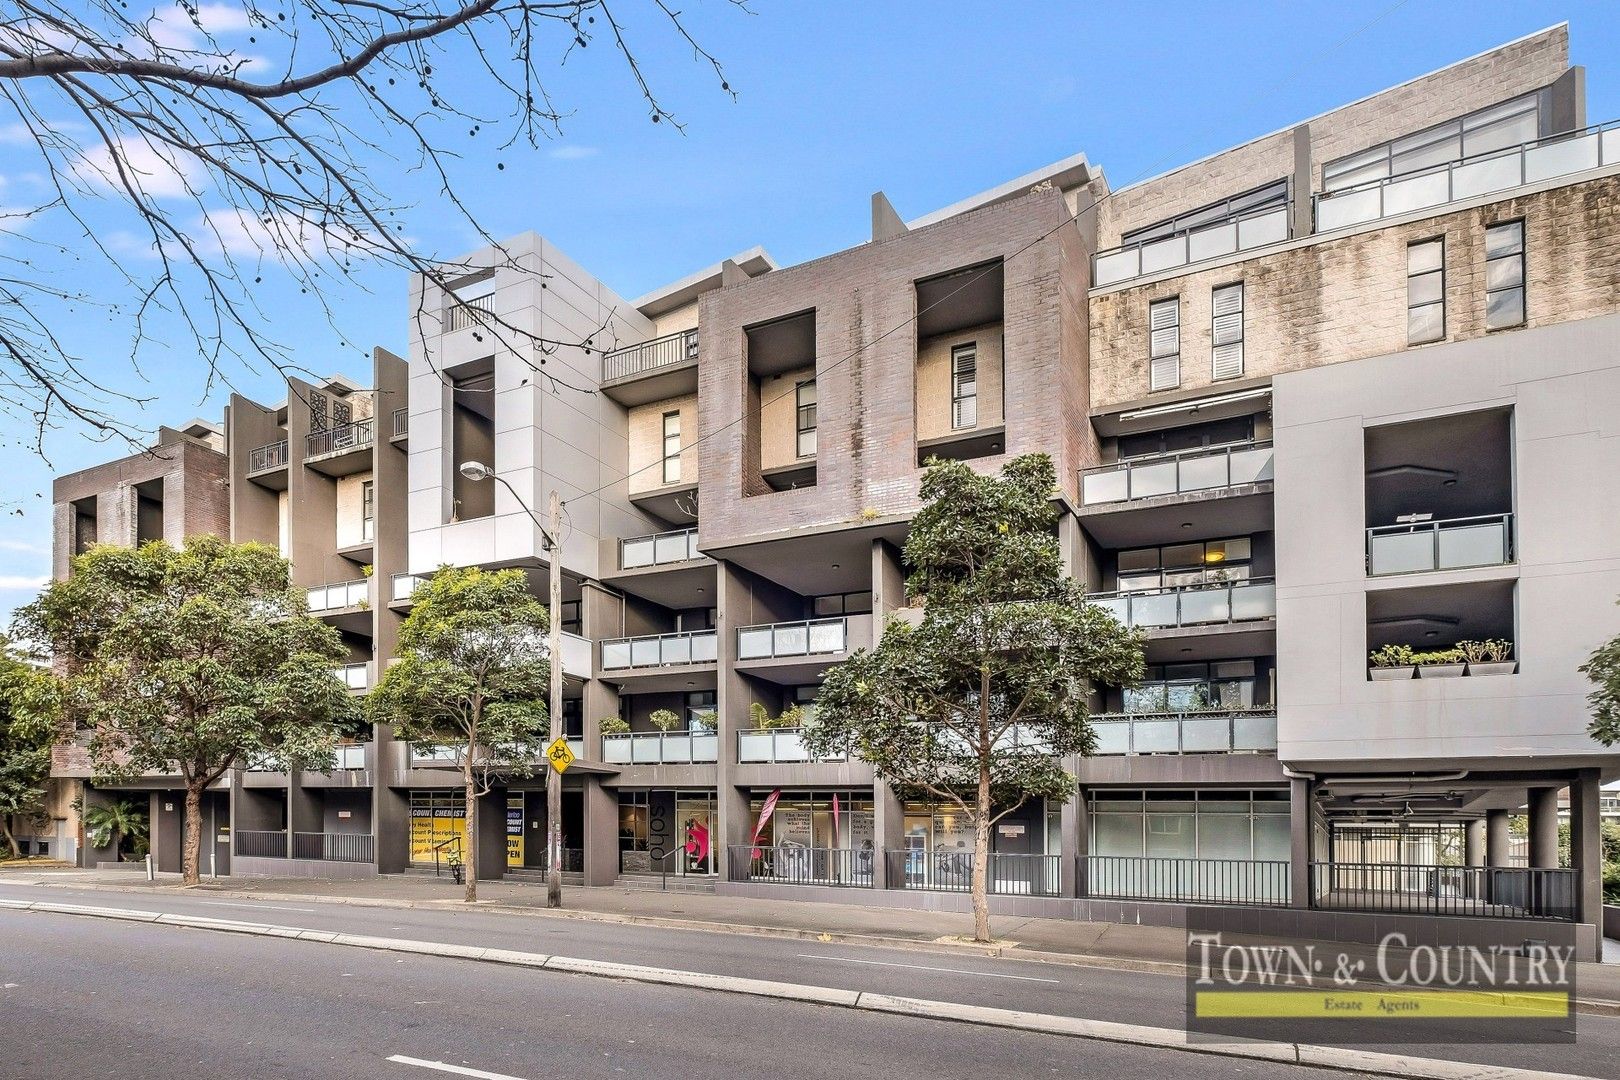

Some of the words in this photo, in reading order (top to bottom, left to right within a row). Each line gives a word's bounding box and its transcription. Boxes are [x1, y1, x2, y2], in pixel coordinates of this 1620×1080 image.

[411, 809, 432, 817] COUNT
[507, 839, 520, 848] OW
[507, 850, 521, 859] PEN
